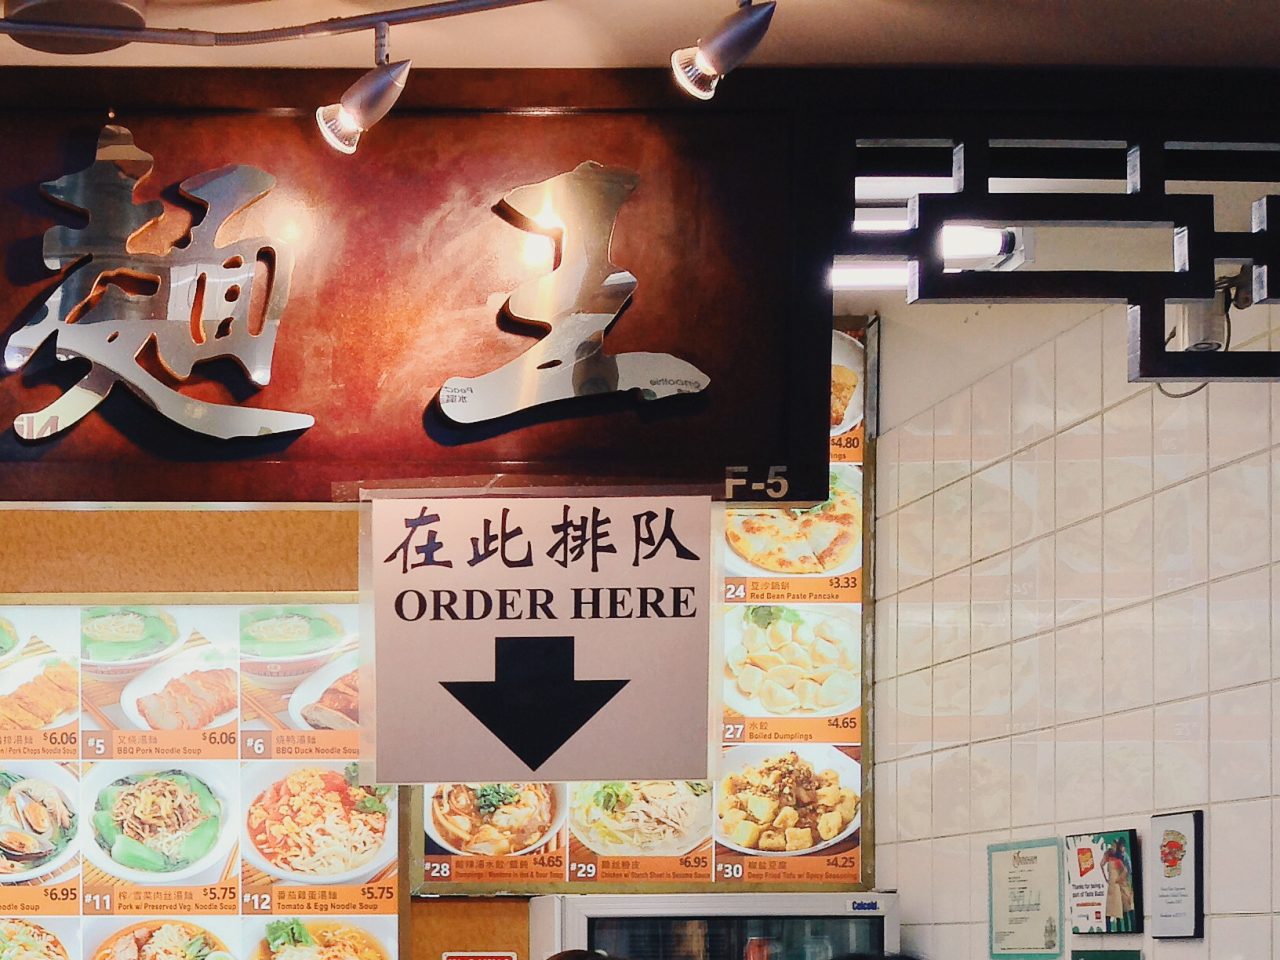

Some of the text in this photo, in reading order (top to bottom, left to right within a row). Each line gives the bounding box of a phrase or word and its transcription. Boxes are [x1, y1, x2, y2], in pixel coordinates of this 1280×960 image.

[725, 465, 789, 498] F-5
[383, 504, 701, 574] 在此排队
[829, 577, 857, 588] $3.33
[394, 586, 697, 622] ORDER HERE
[828, 718, 857, 729] $4.65
[43, 732, 77, 745] $6.06
[202, 732, 236, 745] $6.06
[774, 733, 813, 741] Dumplings
[87, 737, 105, 754] #5
[117, 747, 134, 755] BBQ
[183, 747, 201, 755] Soup
[246, 737, 264, 754] #6
[276, 747, 292, 755] BBQ
[533, 856, 562, 867] $4.65
[679, 857, 708, 868] $6.95
[827, 857, 855, 868] $4.25
[424, 862, 450, 877] #28
[570, 863, 596, 877] #29
[717, 864, 742, 878] #30
[43, 888, 77, 901] $6.95
[203, 887, 236, 900] $5.75
[361, 887, 394, 900] $5.75
[85, 894, 110, 910] #11
[219, 903, 236, 911] Soup
[243, 893, 271, 910] #12
[314, 903, 328, 911] Egg
[359, 903, 378, 911] Soup
